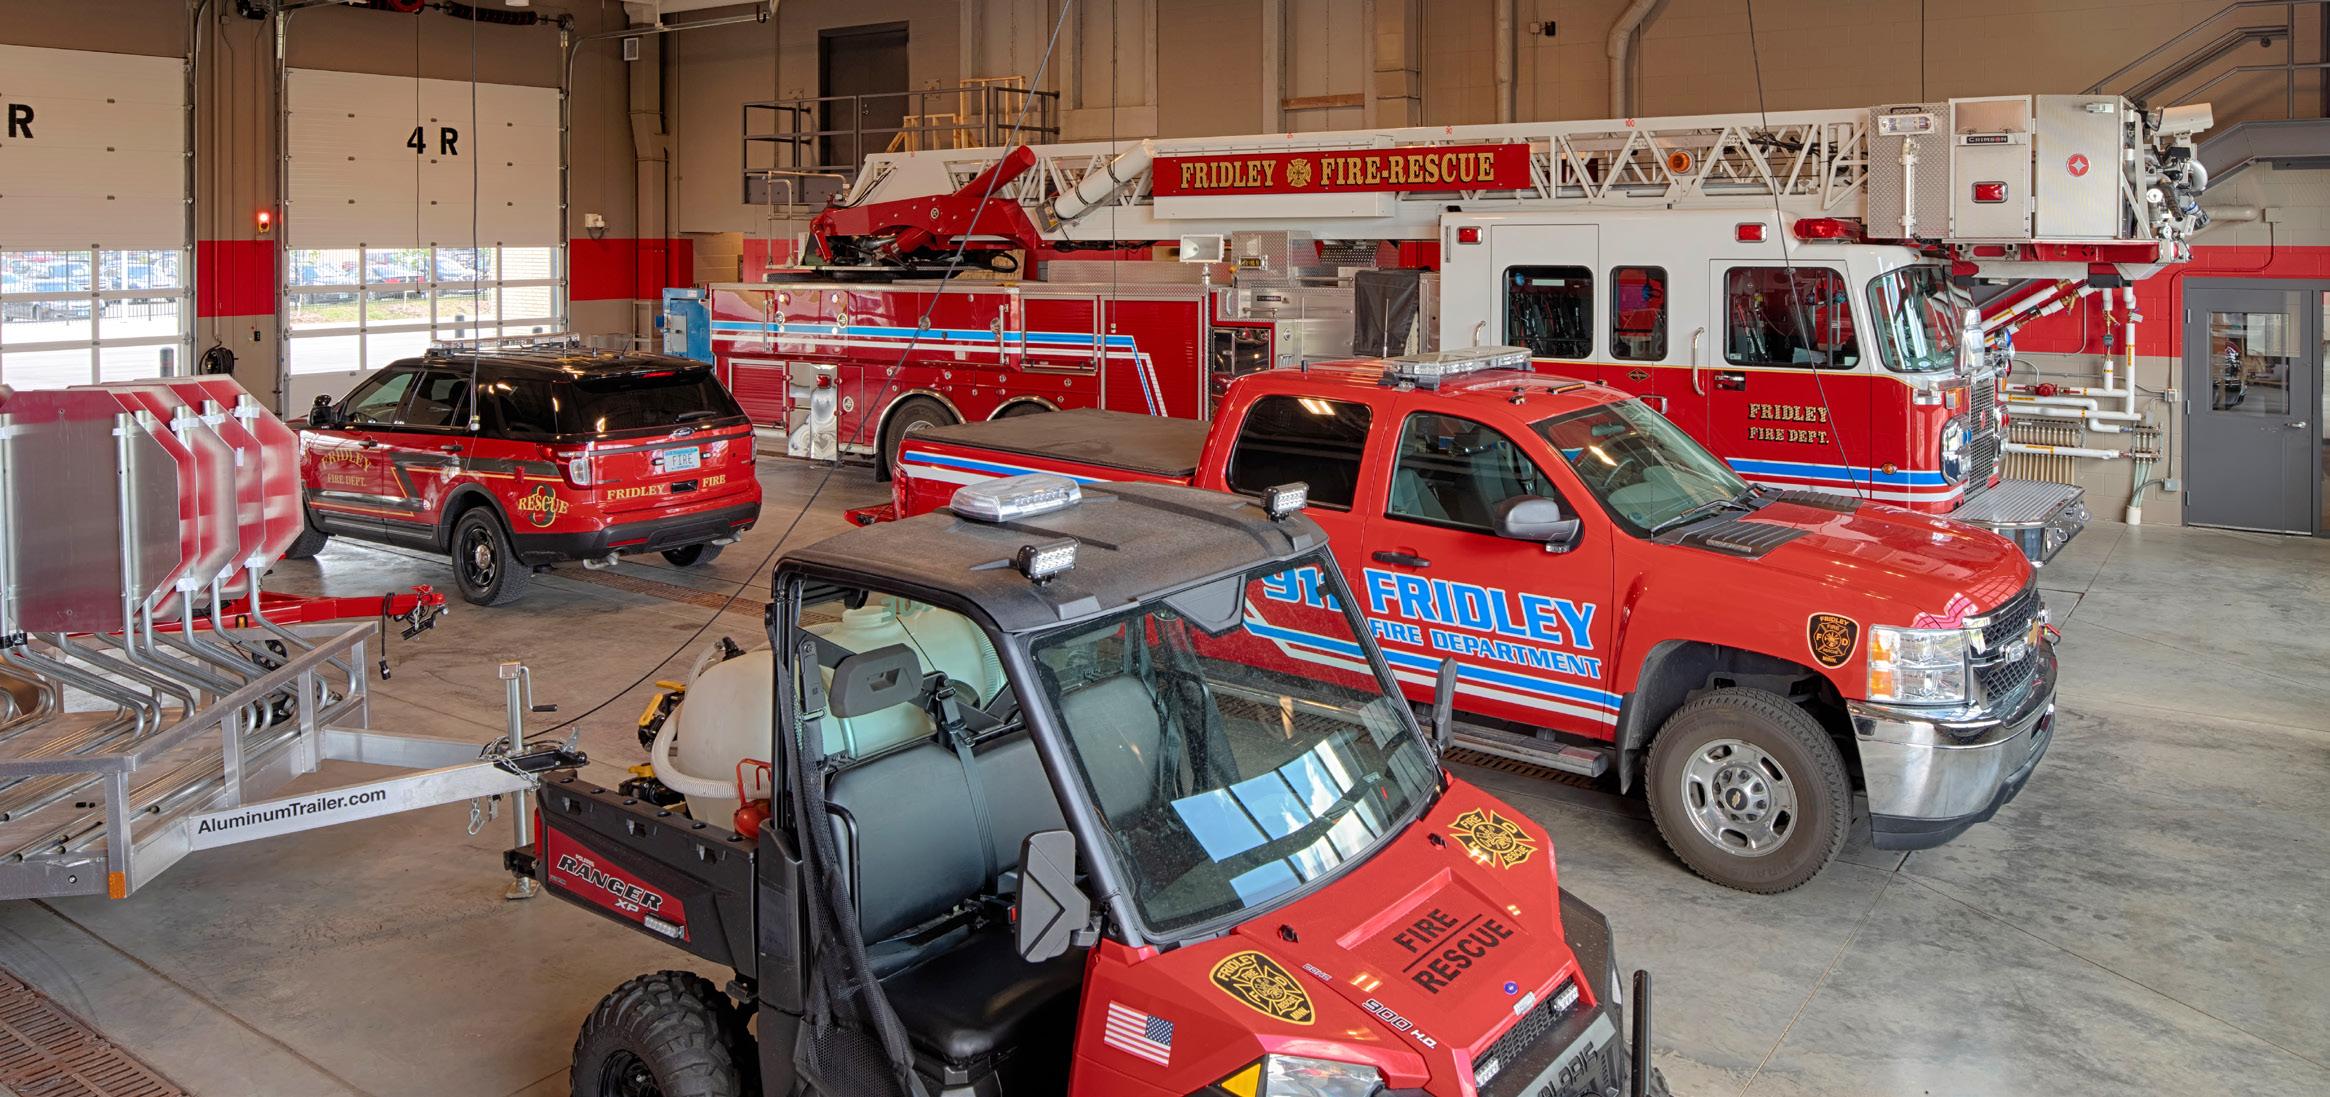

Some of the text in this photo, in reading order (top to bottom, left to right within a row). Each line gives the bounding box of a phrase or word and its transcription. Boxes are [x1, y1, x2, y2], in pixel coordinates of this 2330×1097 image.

[8, 103, 34, 138] R
[407, 126, 458, 155] 4 R
[1968, 136, 2007, 144] CRIMSON
[1180, 160, 1276, 189] FRIDLEY
[1320, 152, 1494, 186] FIRE-RESCUE
[1747, 403, 1829, 423] FRIDLEY
[1748, 426, 1830, 445] FIRE DEPT.
[321, 448, 372, 472] FRIDLEY
[671, 453, 694, 466] FIRE
[327, 473, 368, 487] FIRE DEPT.
[607, 475, 726, 500] FRIDLEY FIRE
[518, 495, 569, 514] RESCUE
[1363, 567, 1596, 650] FRIDLEY
[1820, 616, 1849, 625] FRIDLEY
[1367, 617, 1602, 679] FIRE DEPARTMENT
[1841, 638, 1849, 646] D
[198, 789, 386, 834] AluminumTrailer.com
[1461, 814, 1481, 828] FIRE
[1503, 845, 1529, 863] RESCUE
[557, 854, 663, 911] RANGER
[614, 899, 639, 912] XP
[1393, 908, 1459, 954] FIRE
[1217, 955, 1256, 981] FRIDLEY
[1411, 919, 1514, 994] RESCUE
[1362, 998, 1414, 1032] 900
